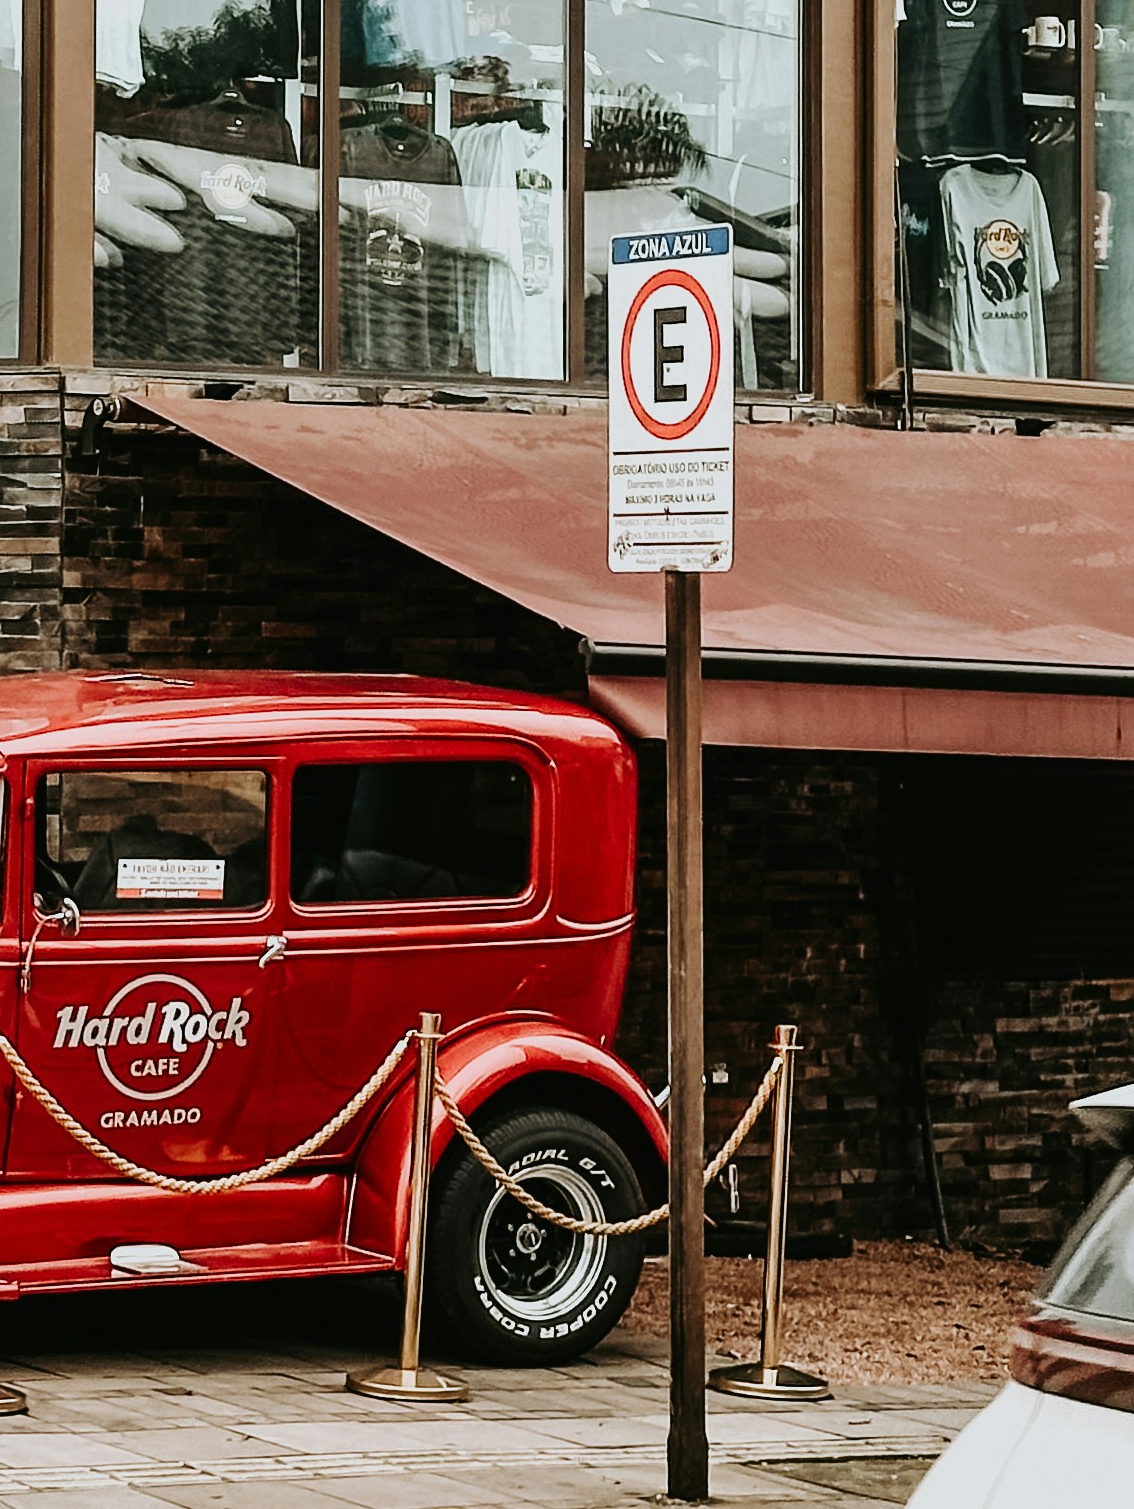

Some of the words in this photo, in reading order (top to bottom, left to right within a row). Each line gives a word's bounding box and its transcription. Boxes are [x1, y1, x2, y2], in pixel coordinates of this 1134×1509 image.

[629, 237, 669, 260] ZONA
[672, 232, 712, 255] AZUL
[654, 306, 687, 403] E
[669, 462, 685, 473] USO
[688, 462, 699, 473] DO
[702, 461, 729, 472] TICKET
[53, 1002, 157, 1048] Hard
[158, 997, 250, 1053] Rock
[130, 1058, 179, 1077] CAFE
[100, 1107, 201, 1129] GRAMADO
[496, 1149, 569, 1188] ADIAL
[474, 1276, 530, 1337] COBRA
[540, 1275, 617, 1338] COOPER
